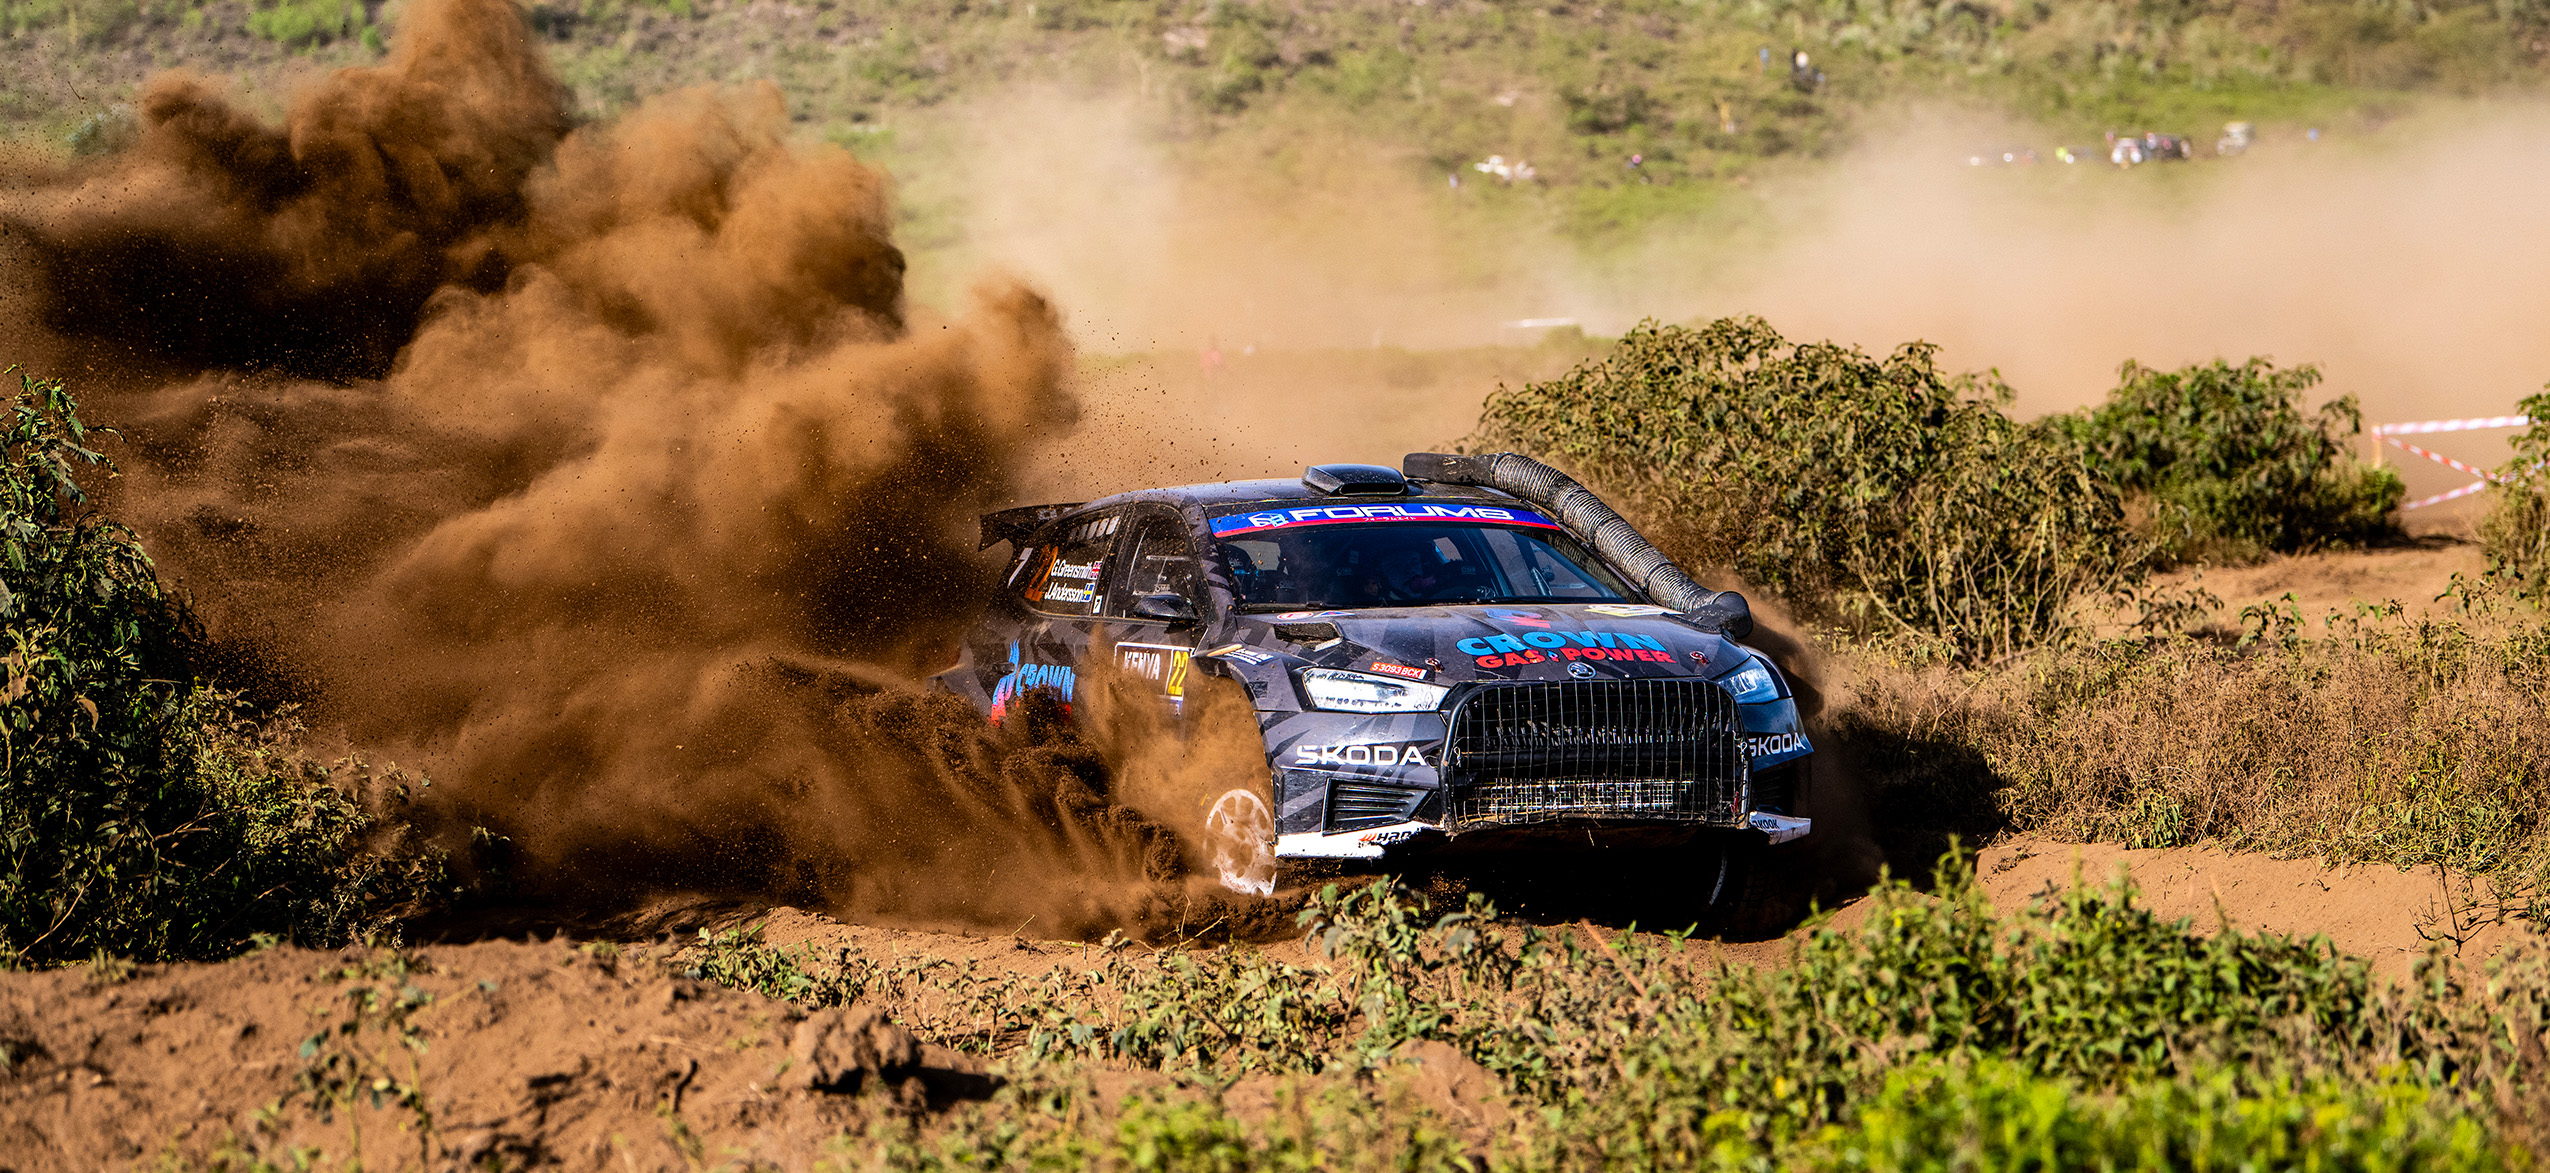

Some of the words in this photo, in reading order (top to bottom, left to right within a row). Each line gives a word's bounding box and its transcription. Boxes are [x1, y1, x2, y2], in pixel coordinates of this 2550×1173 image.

[1288, 505, 1515, 521] FORUM8
[1456, 630, 1668, 656] CROWN
[1123, 650, 1160, 680] KENYA
[1476, 649, 1546, 669] GAS
[1559, 647, 1677, 665] POWER
[1168, 650, 1189, 695] 22
